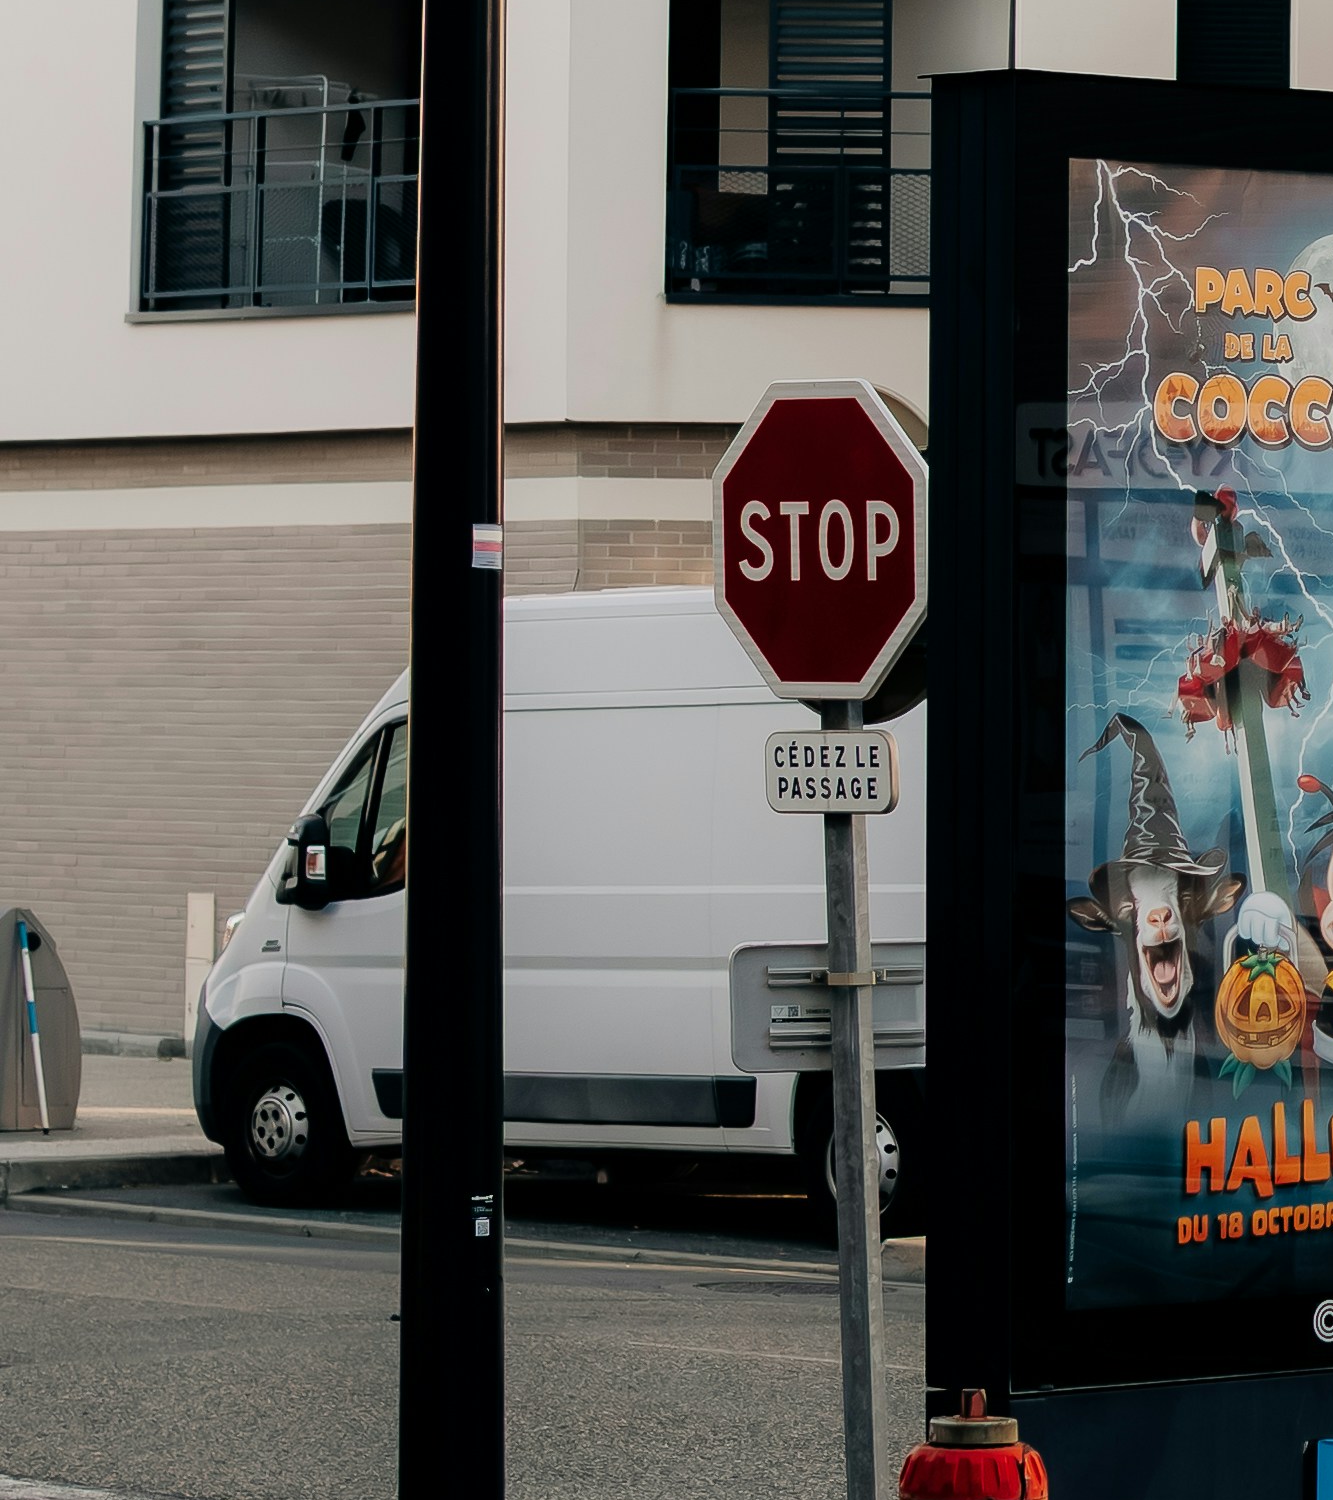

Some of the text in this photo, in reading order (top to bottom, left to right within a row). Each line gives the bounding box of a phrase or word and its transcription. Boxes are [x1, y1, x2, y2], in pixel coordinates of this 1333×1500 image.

[1195, 266, 1316, 321] PARC
[1224, 332, 1293, 362] DE LA
[739, 500, 900, 582] STOP
[774, 741, 880, 768] CÉDEZ LE
[778, 777, 879, 800] PASSAGE
[1177, 1213, 1209, 1245] DU
[1217, 1211, 1244, 1240] 18
